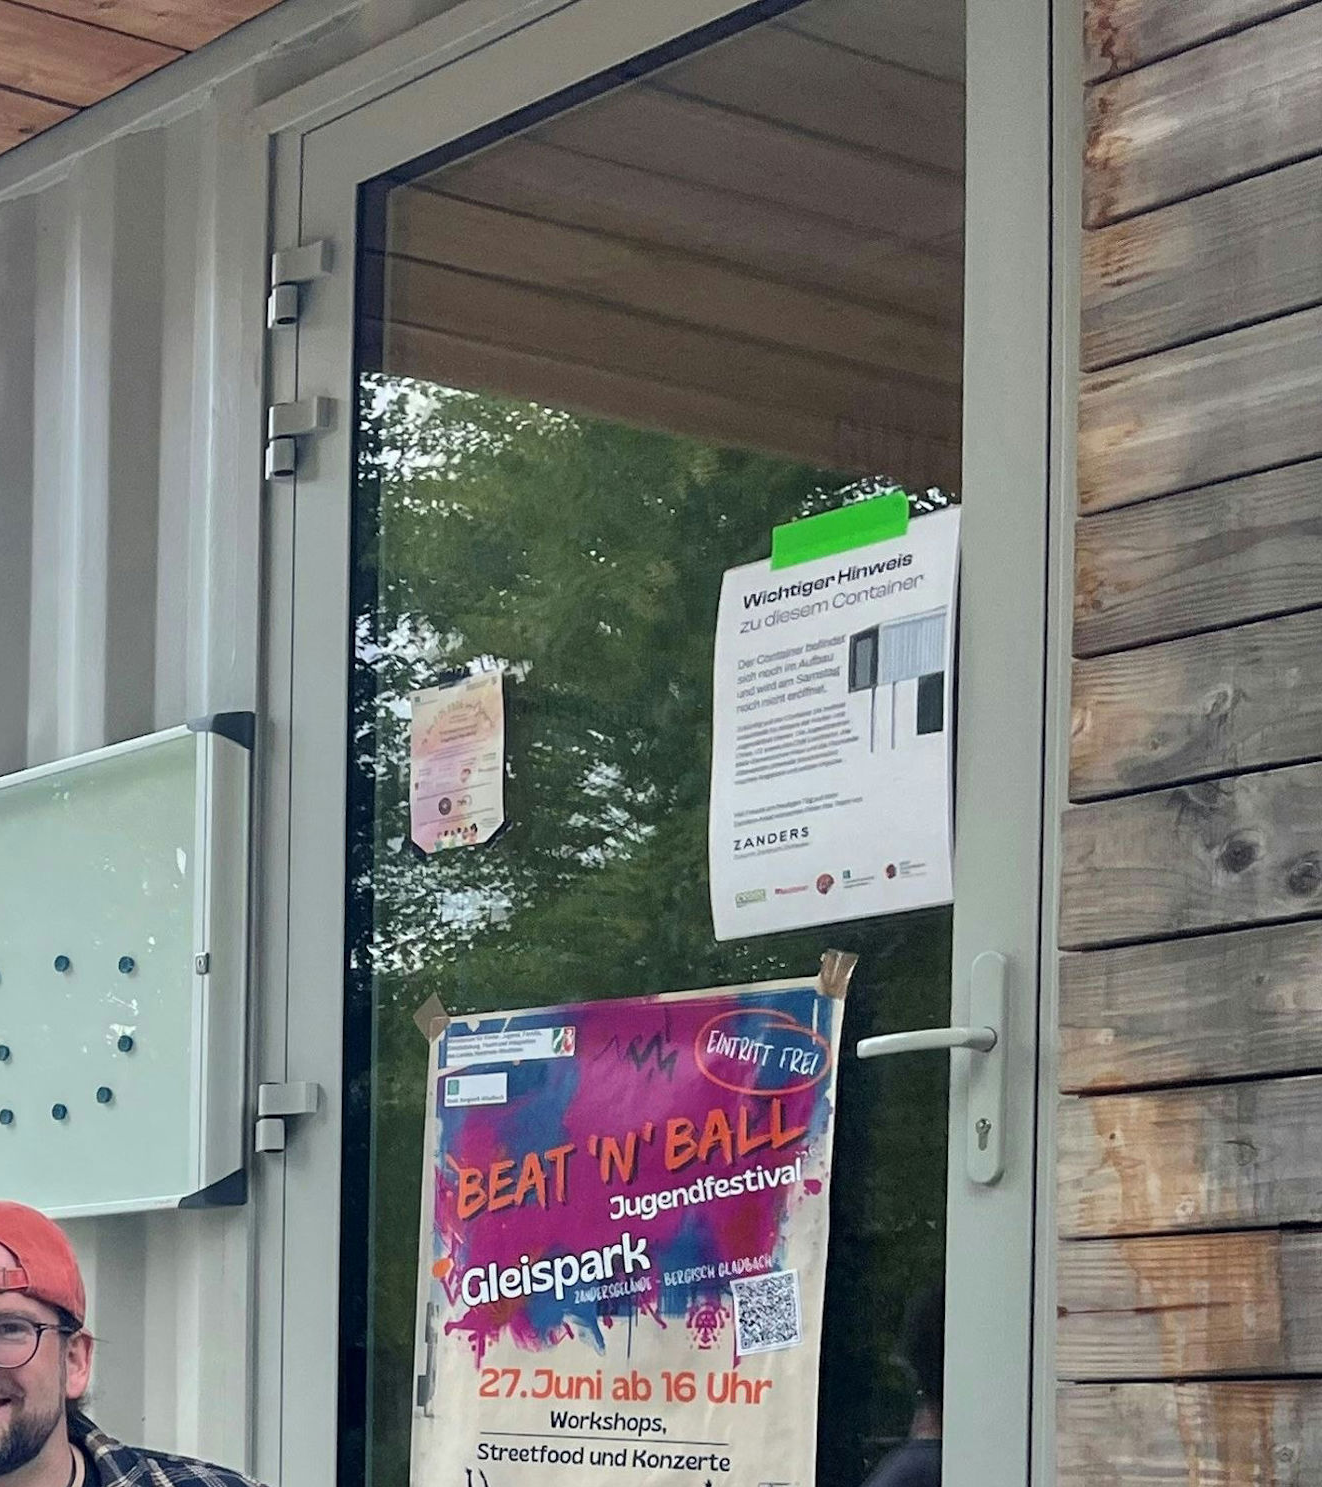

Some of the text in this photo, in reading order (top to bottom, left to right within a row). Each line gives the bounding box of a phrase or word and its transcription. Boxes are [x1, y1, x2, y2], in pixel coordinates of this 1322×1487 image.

[739, 573, 925, 634] zu diesem Container
[743, 553, 914, 609] Wichtiger Hinweis
[733, 826, 810, 851] ZANDERS
[707, 1029, 819, 1076] EINTRITT FREI
[449, 1142, 575, 1219] BEAT
[664, 1098, 808, 1172] BALL
[609, 1156, 802, 1221] Jugendfestival
[461, 1231, 651, 1307] Gleispark
[663, 1264, 715, 1287] BERGISCH
[717, 1255, 774, 1278] GLADBACH
[611, 1370, 652, 1401] ab
[661, 1371, 697, 1402] 16
[706, 1370, 773, 1406] Uhr
[550, 1410, 667, 1437] Workshops,
[476, 1442, 731, 1472] Streetfood und Konzerte
